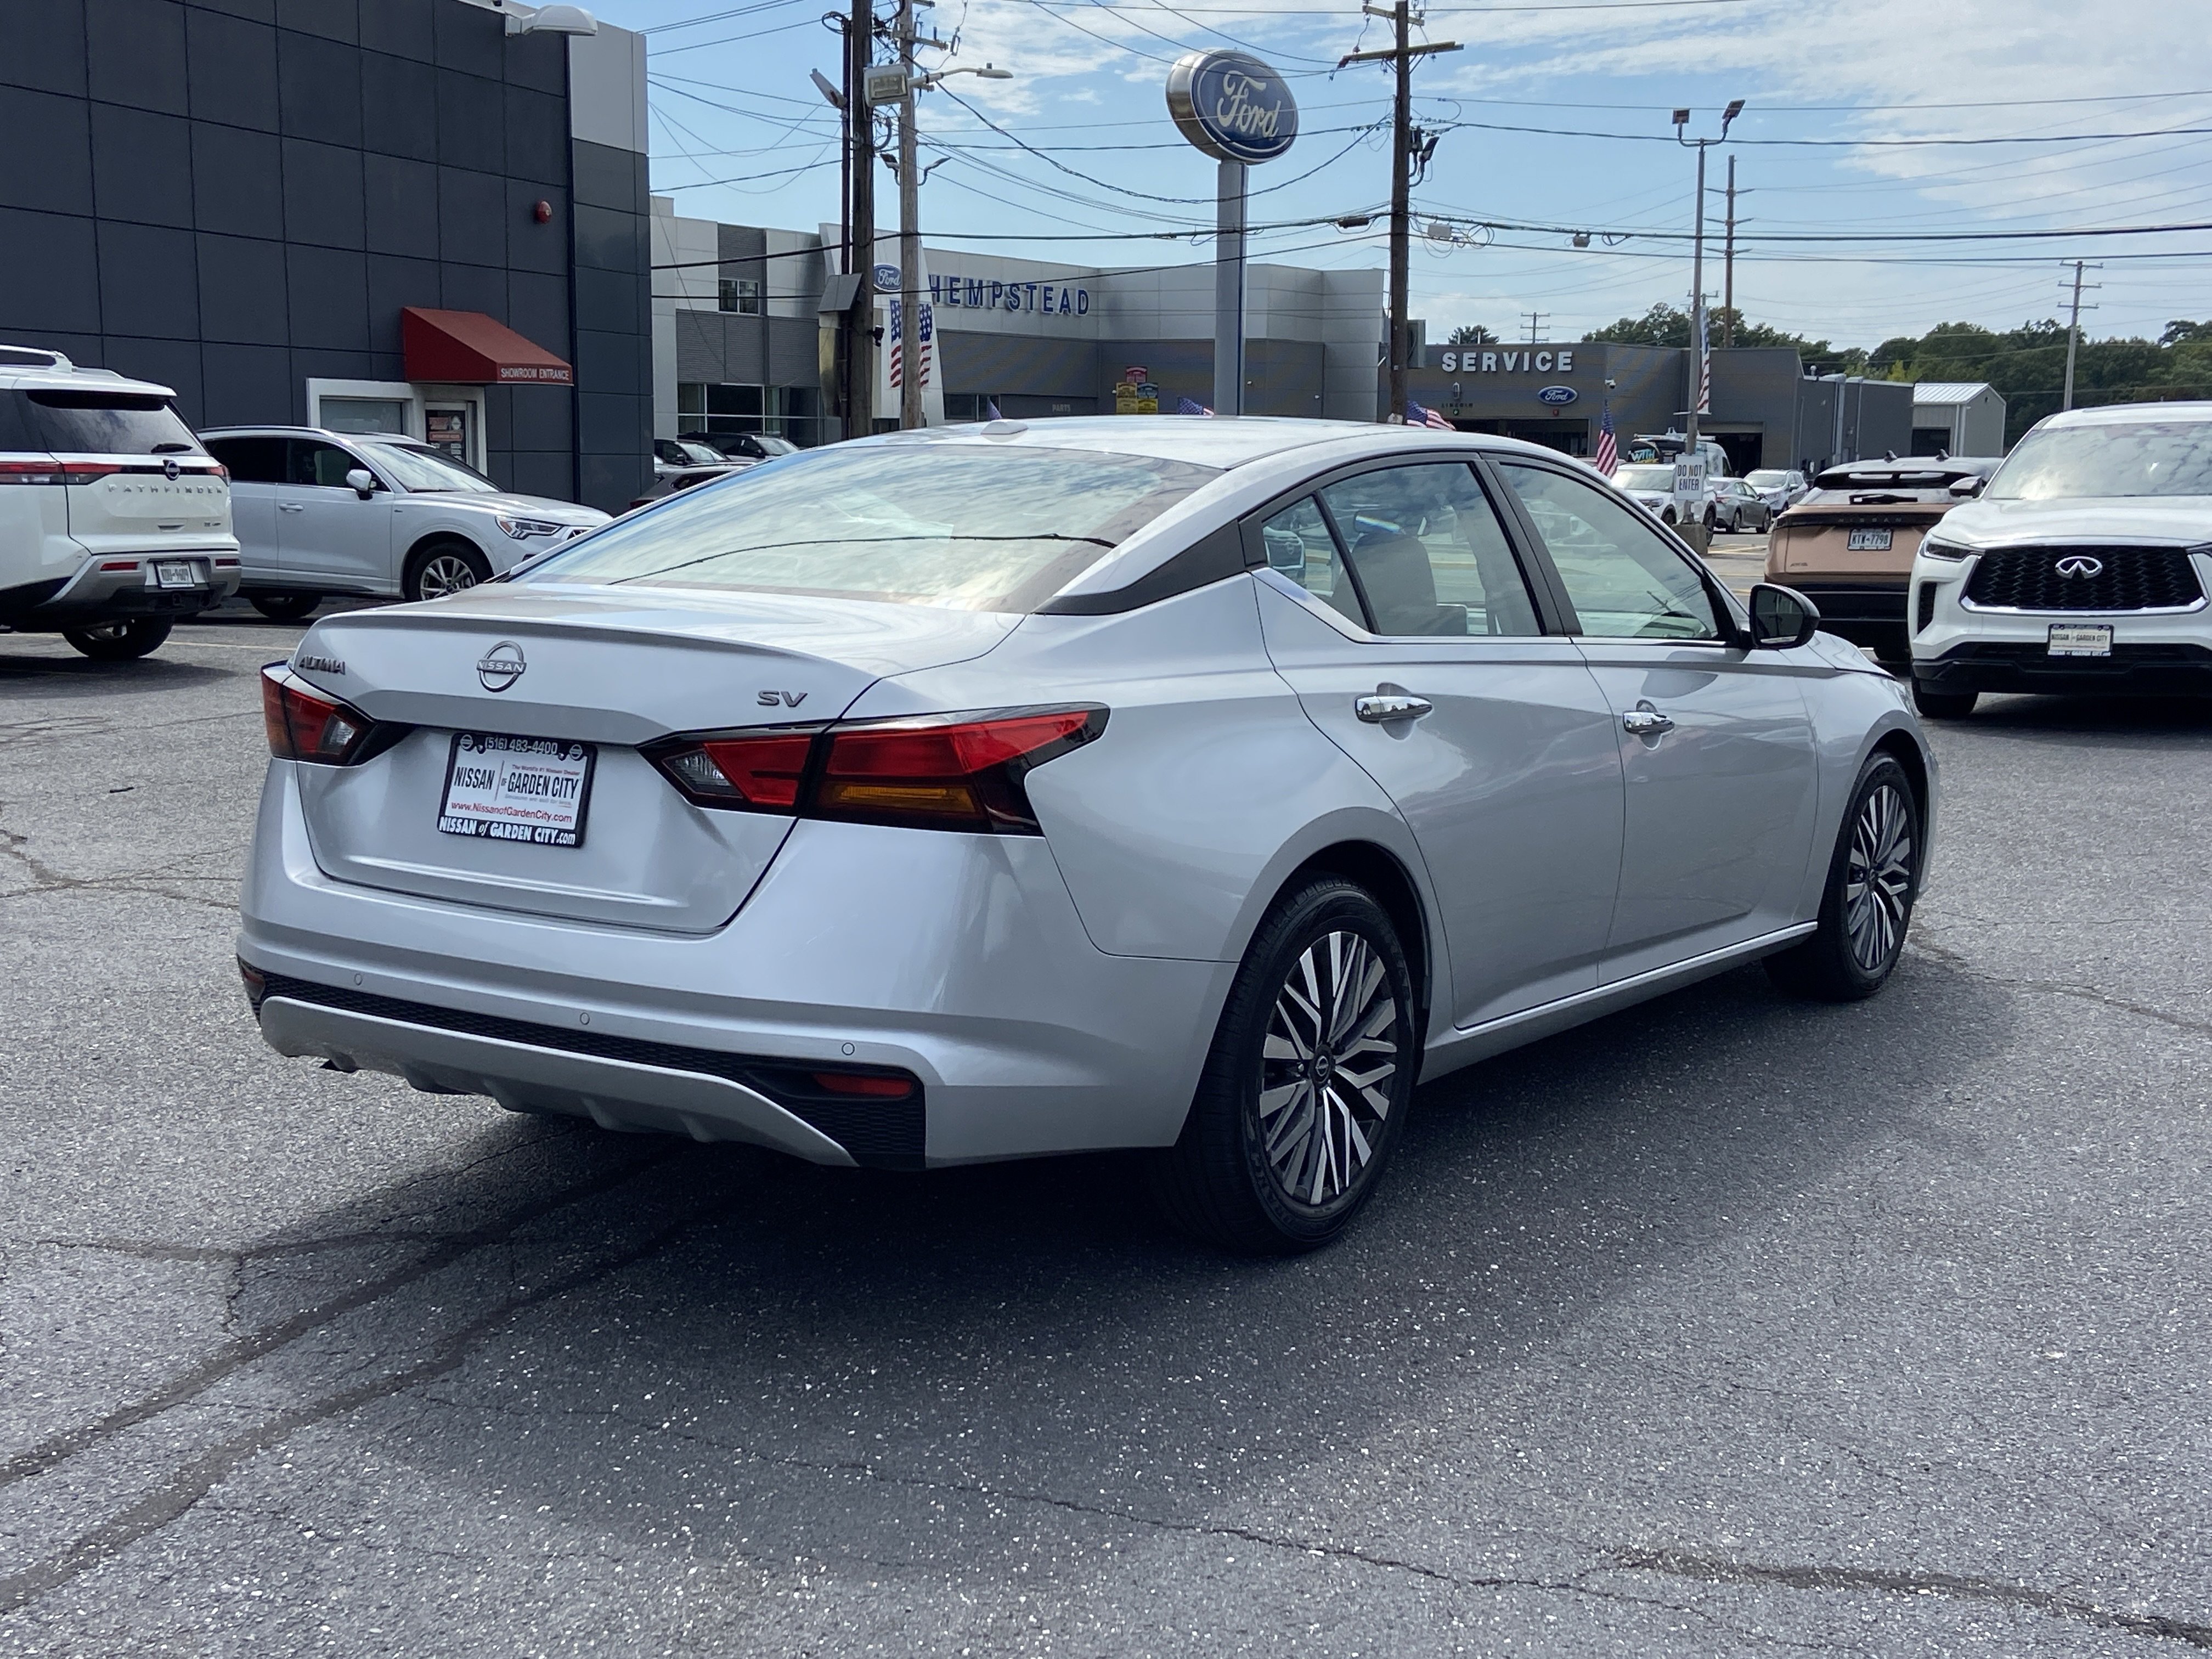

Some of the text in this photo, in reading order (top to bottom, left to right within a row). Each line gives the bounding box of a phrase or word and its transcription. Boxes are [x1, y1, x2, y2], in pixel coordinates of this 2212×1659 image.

[1217, 70, 1281, 140] Ford
[877, 267, 901, 286] Ford
[929, 274, 1090, 315] HEMPSTEAD
[1442, 351, 1573, 372] SERVICE
[500, 368, 569, 380] SHOWROOM ENTRANCE
[1544, 390, 1568, 400] Ford
[1631, 449, 1655, 461] WITH
[1678, 465, 1702, 478] DO NOT
[108, 484, 222, 494] PATHFINDER
[1679, 479, 1699, 490] ENTER
[298, 655, 345, 675] ALTIMA
[477, 661, 525, 672] NISSAN
[757, 690, 808, 707] SV
[484, 737, 558, 755] (516) 483-4400
[454, 766, 495, 790] NISSAN
[507, 772, 551, 796] GARDEN
[551, 777, 579, 799] CITY
[451, 802, 572, 823] www.NissanofGardenCity.com
[439, 816, 477, 834] NISSAN
[479, 822, 490, 836] of
[490, 822, 531, 841] GARDEN
